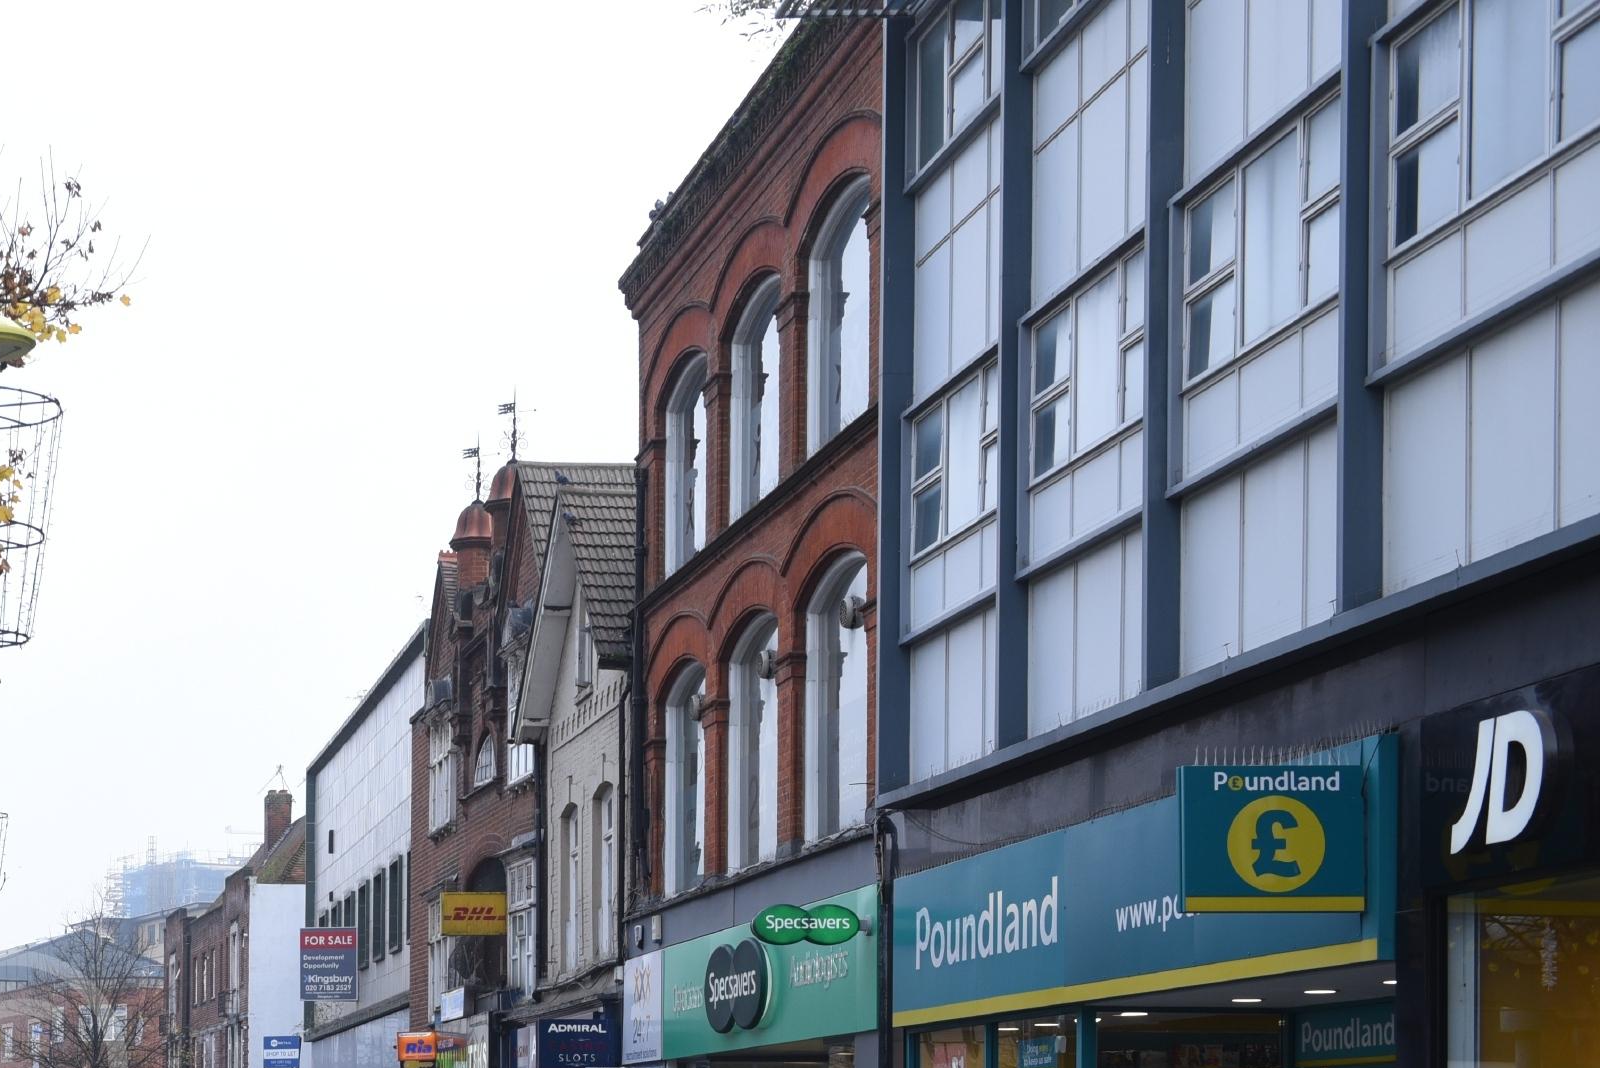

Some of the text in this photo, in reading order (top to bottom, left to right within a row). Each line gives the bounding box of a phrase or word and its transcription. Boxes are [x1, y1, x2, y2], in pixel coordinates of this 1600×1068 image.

[1450, 710, 1544, 855] JD
[452, 906, 497, 921] DHL
[765, 914, 850, 932] Specsavers
[915, 875, 1058, 970] Poundland
[304, 935, 353, 945] FOR SALE
[303, 962, 339, 970] Opportunity
[307, 974, 354, 985] Kingsbury
[708, 970, 756, 1010] Specsavers
[548, 1022, 607, 1034] ADMIRAL
[1301, 1014, 1396, 1052] Poundland
[558, 1053, 596, 1063] SLOTS
